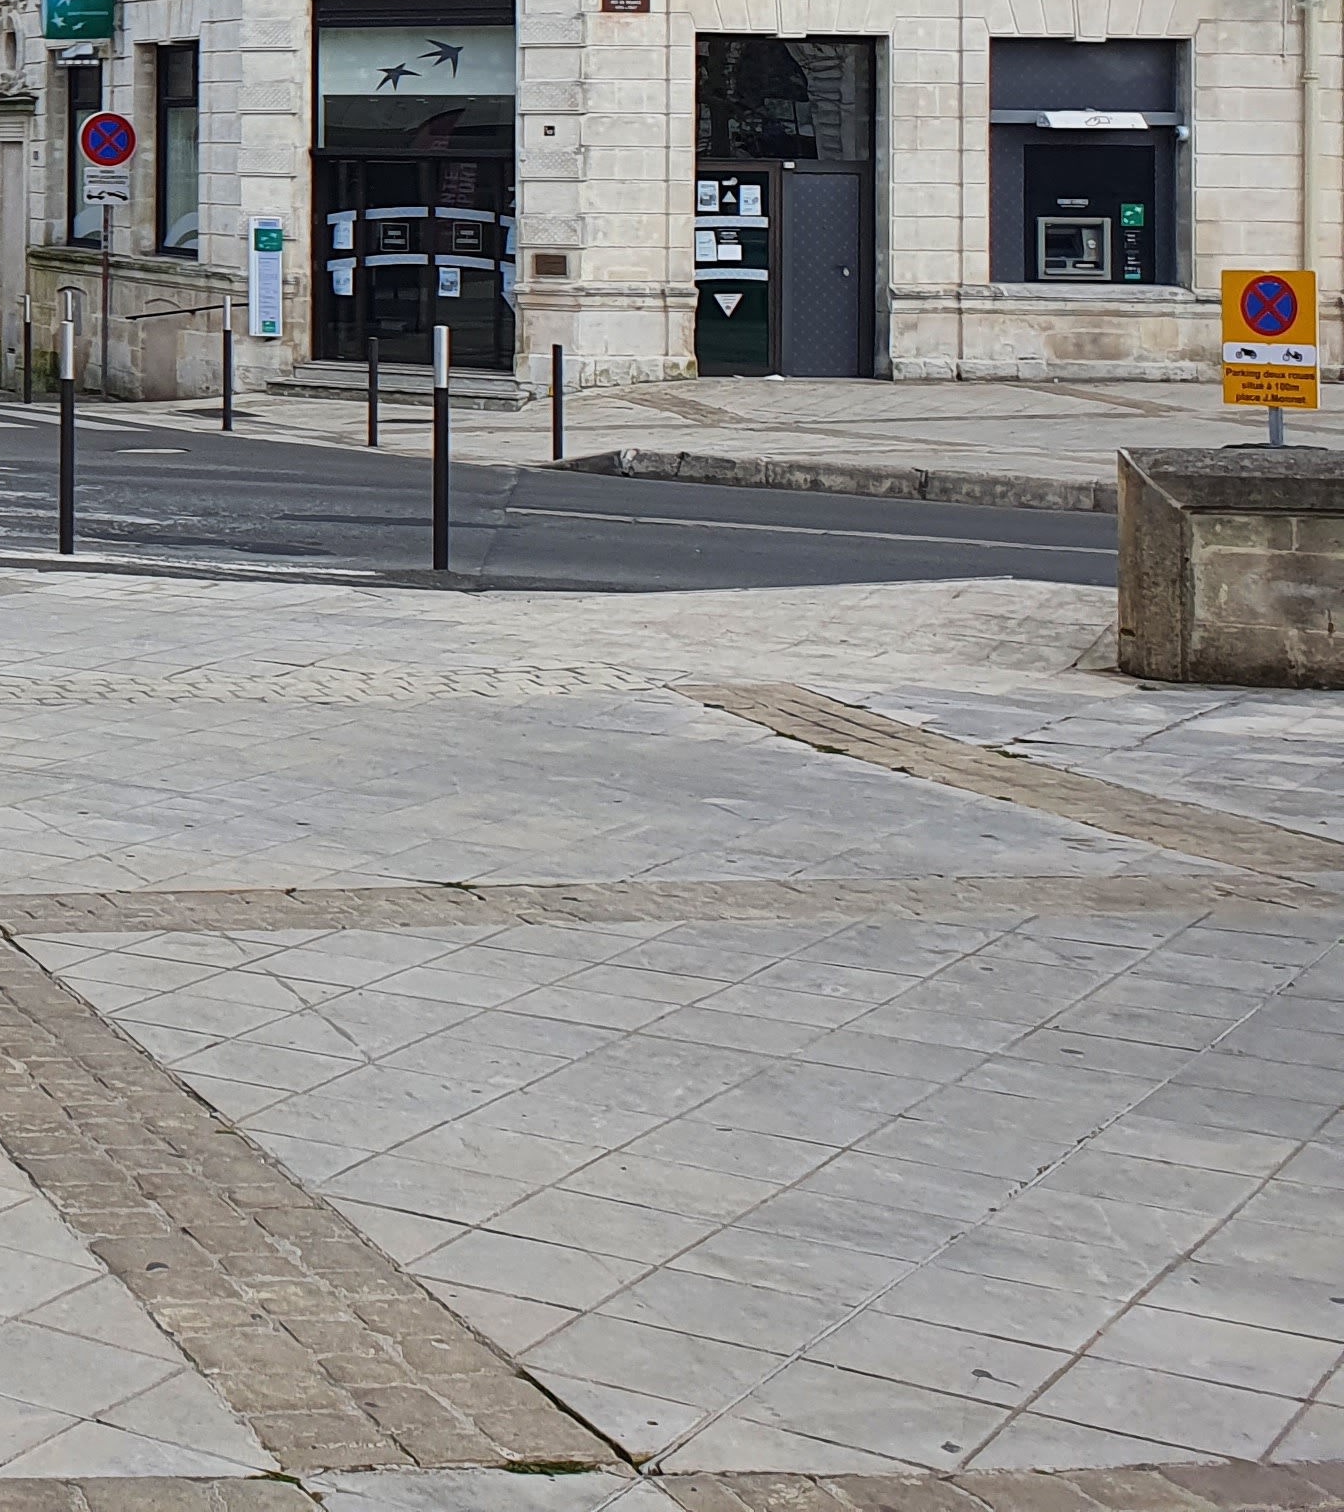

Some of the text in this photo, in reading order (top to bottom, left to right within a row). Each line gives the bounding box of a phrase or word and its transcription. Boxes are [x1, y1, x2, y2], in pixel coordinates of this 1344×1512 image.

[1225, 368, 1315, 380] Parking deux roues
[1274, 383, 1300, 391] 100m
[1235, 393, 1261, 402] place
